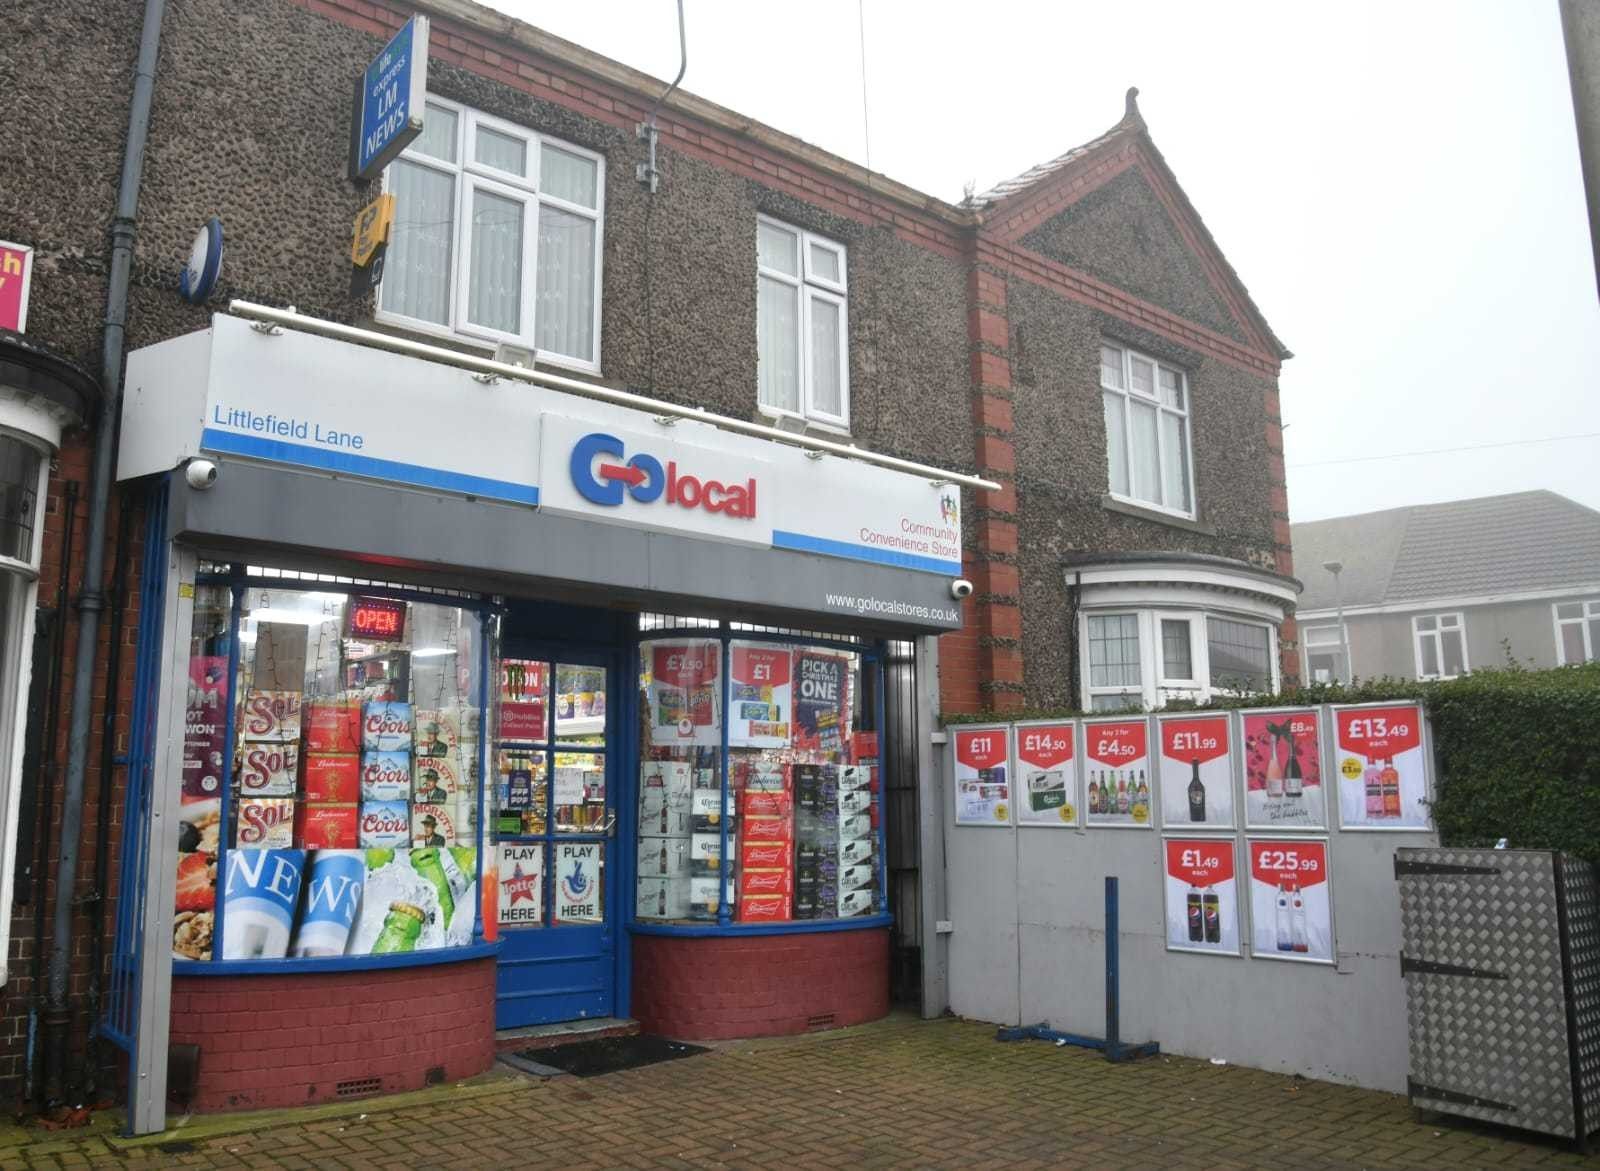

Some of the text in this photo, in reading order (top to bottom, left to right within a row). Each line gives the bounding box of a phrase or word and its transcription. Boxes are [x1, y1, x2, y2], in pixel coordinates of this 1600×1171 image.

[378, 80, 398, 120] LM
[366, 101, 405, 159] NEWS
[214, 404, 364, 449] Littlefield Lane
[901, 518, 958, 544] Community
[860, 527, 958, 558] Convenience Store
[826, 593, 958, 622] www.golocalstores.co.uk
[356, 609, 397, 632] OPEN
[753, 664, 771, 680] £1
[802, 659, 838, 675] PICK A
[801, 680, 838, 700] ONE
[366, 714, 411, 734] Coors
[1349, 718, 1409, 738] £13.49
[971, 737, 992, 753] £11
[1025, 735, 1066, 751] £14.50
[1098, 740, 1135, 756] £4.50
[1173, 733, 1217, 750] £11.99
[364, 764, 410, 785] Coors
[416, 758, 456, 795] MORETTI
[362, 814, 409, 834] Coors
[414, 804, 454, 840] MORETTI
[504, 848, 535, 860] PLAY
[564, 846, 593, 858] PLAY
[1182, 850, 1219, 868] £1.49
[1259, 851, 1318, 871] £25.99
[1192, 869, 1208, 877] each
[1279, 872, 1297, 880] each
[501, 908, 535, 921] HERE
[561, 904, 593, 917] HERE
